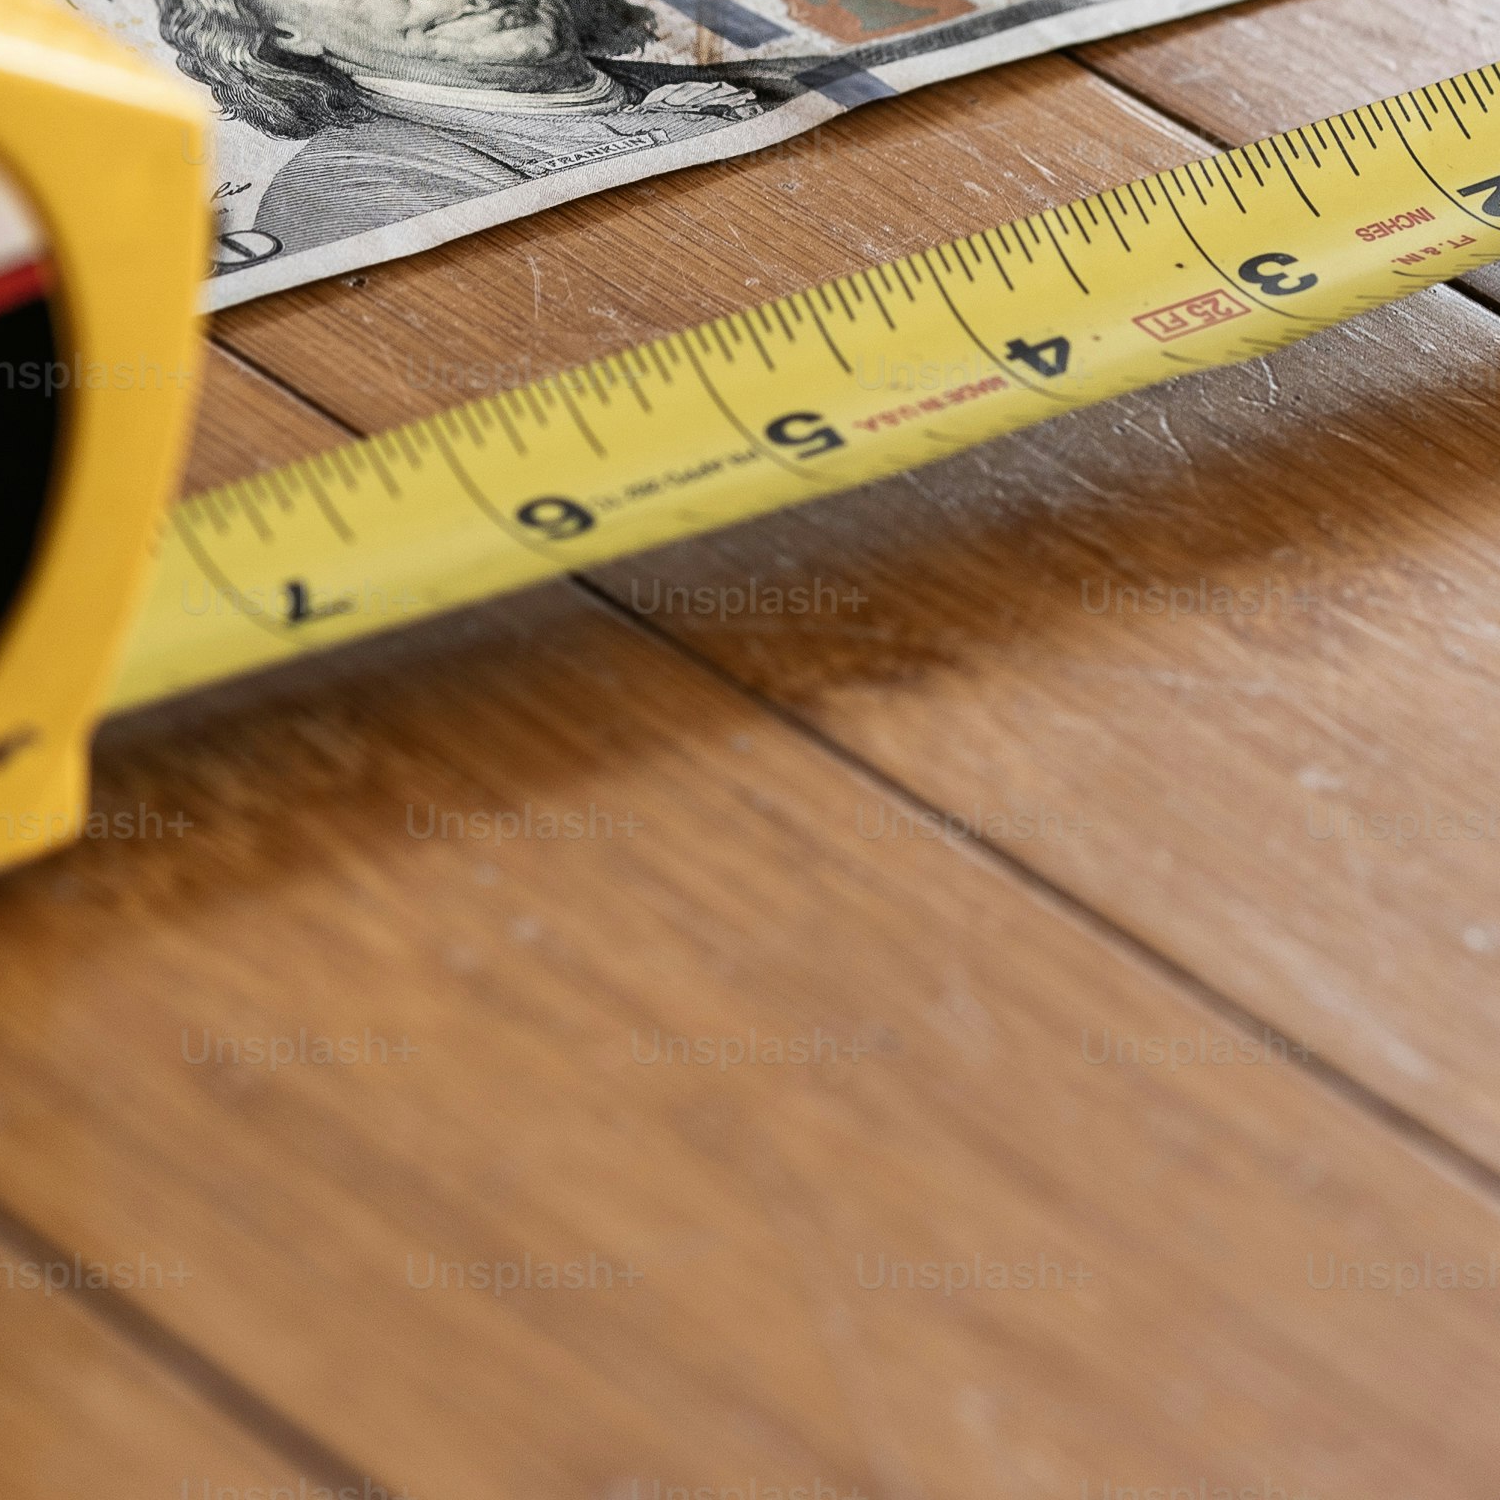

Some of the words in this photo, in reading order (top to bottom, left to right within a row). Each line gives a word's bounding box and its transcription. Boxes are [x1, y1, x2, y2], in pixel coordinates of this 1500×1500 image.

[545, 136, 647, 168] FRANKLIN
[1355, 207, 1436, 242] INCHES
[1237, 252, 1319, 296] 3
[1152, 310, 1188, 333] FT
[1186, 296, 1234, 324] 25
[1004, 336, 1071, 378] 4
[765, 411, 847, 460] 5
[516, 494, 594, 540] 6
